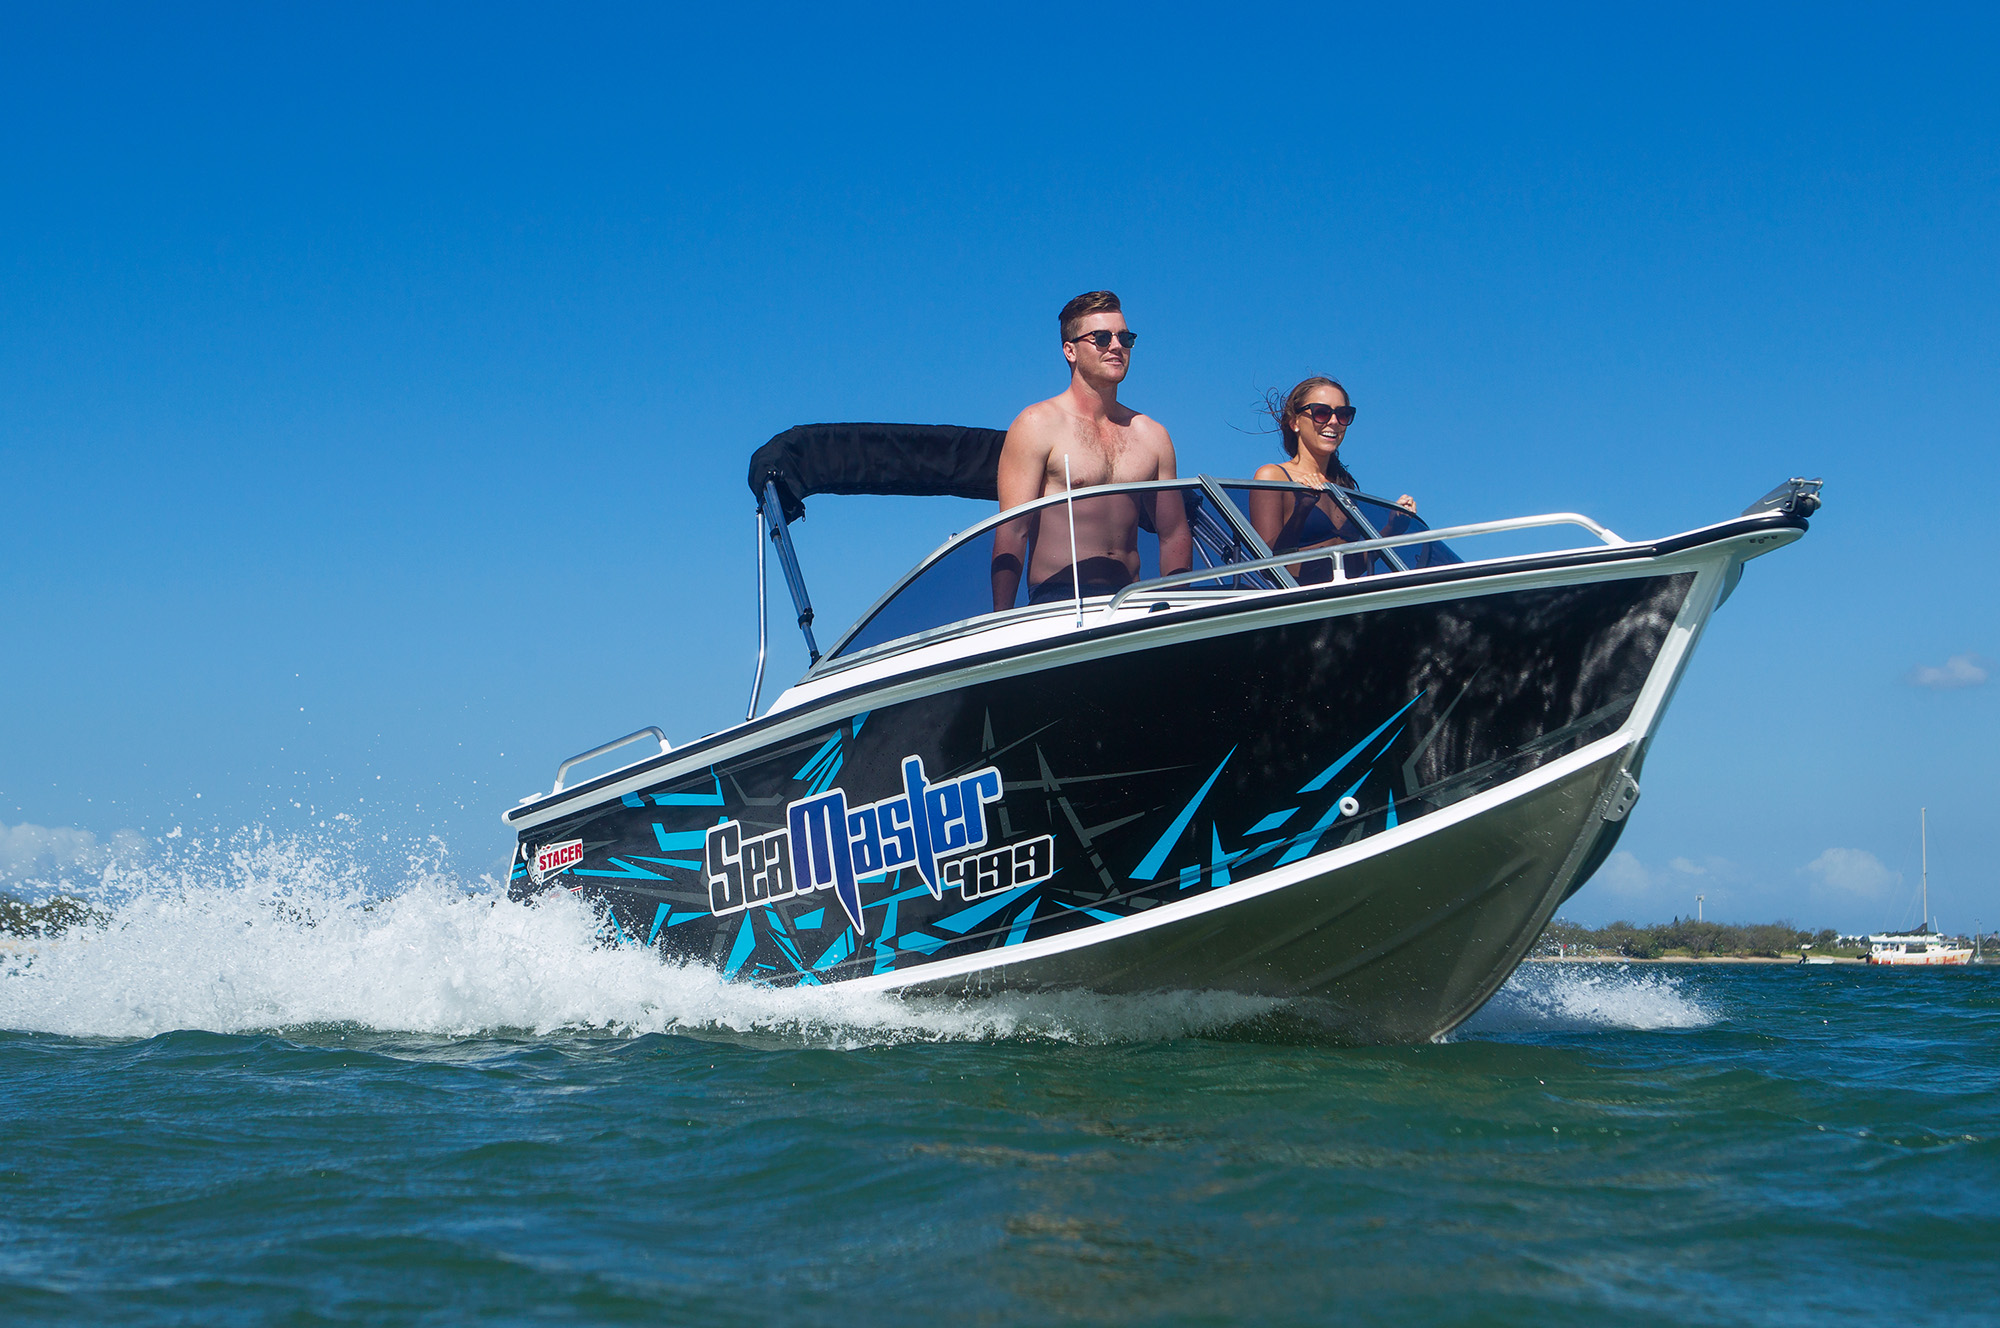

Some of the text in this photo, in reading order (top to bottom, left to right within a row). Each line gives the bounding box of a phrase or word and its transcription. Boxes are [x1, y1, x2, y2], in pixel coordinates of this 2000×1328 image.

[539, 843, 583, 871] STACER
[706, 754, 1003, 935] SeaMaster
[944, 834, 1053, 901] 499
